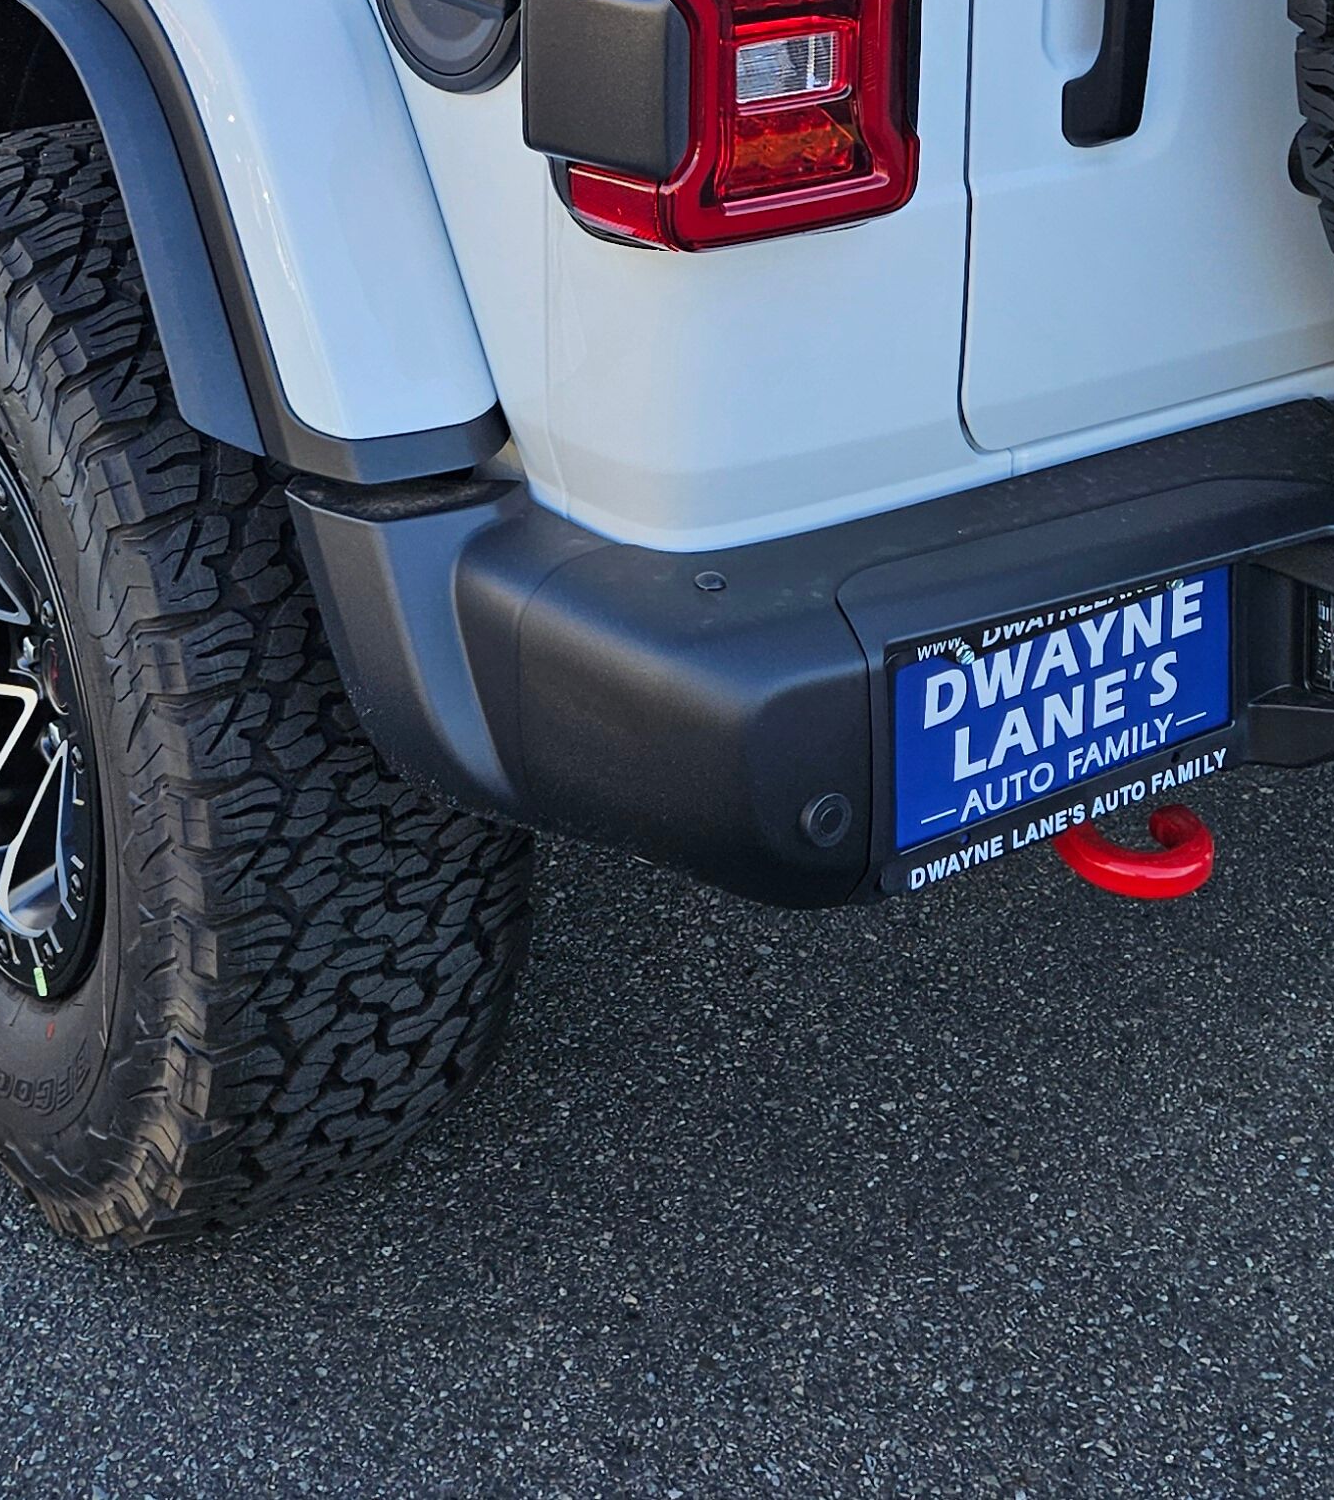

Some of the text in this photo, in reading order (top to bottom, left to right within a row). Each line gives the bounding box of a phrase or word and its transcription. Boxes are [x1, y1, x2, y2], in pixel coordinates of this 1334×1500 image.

[923, 579, 1205, 730] DWAYNE
[952, 651, 1178, 782] LANE'S
[909, 747, 1228, 891] DWAYNE LANE'S AUTO FAMILY
[960, 712, 1176, 823] AUTO FAMILY
